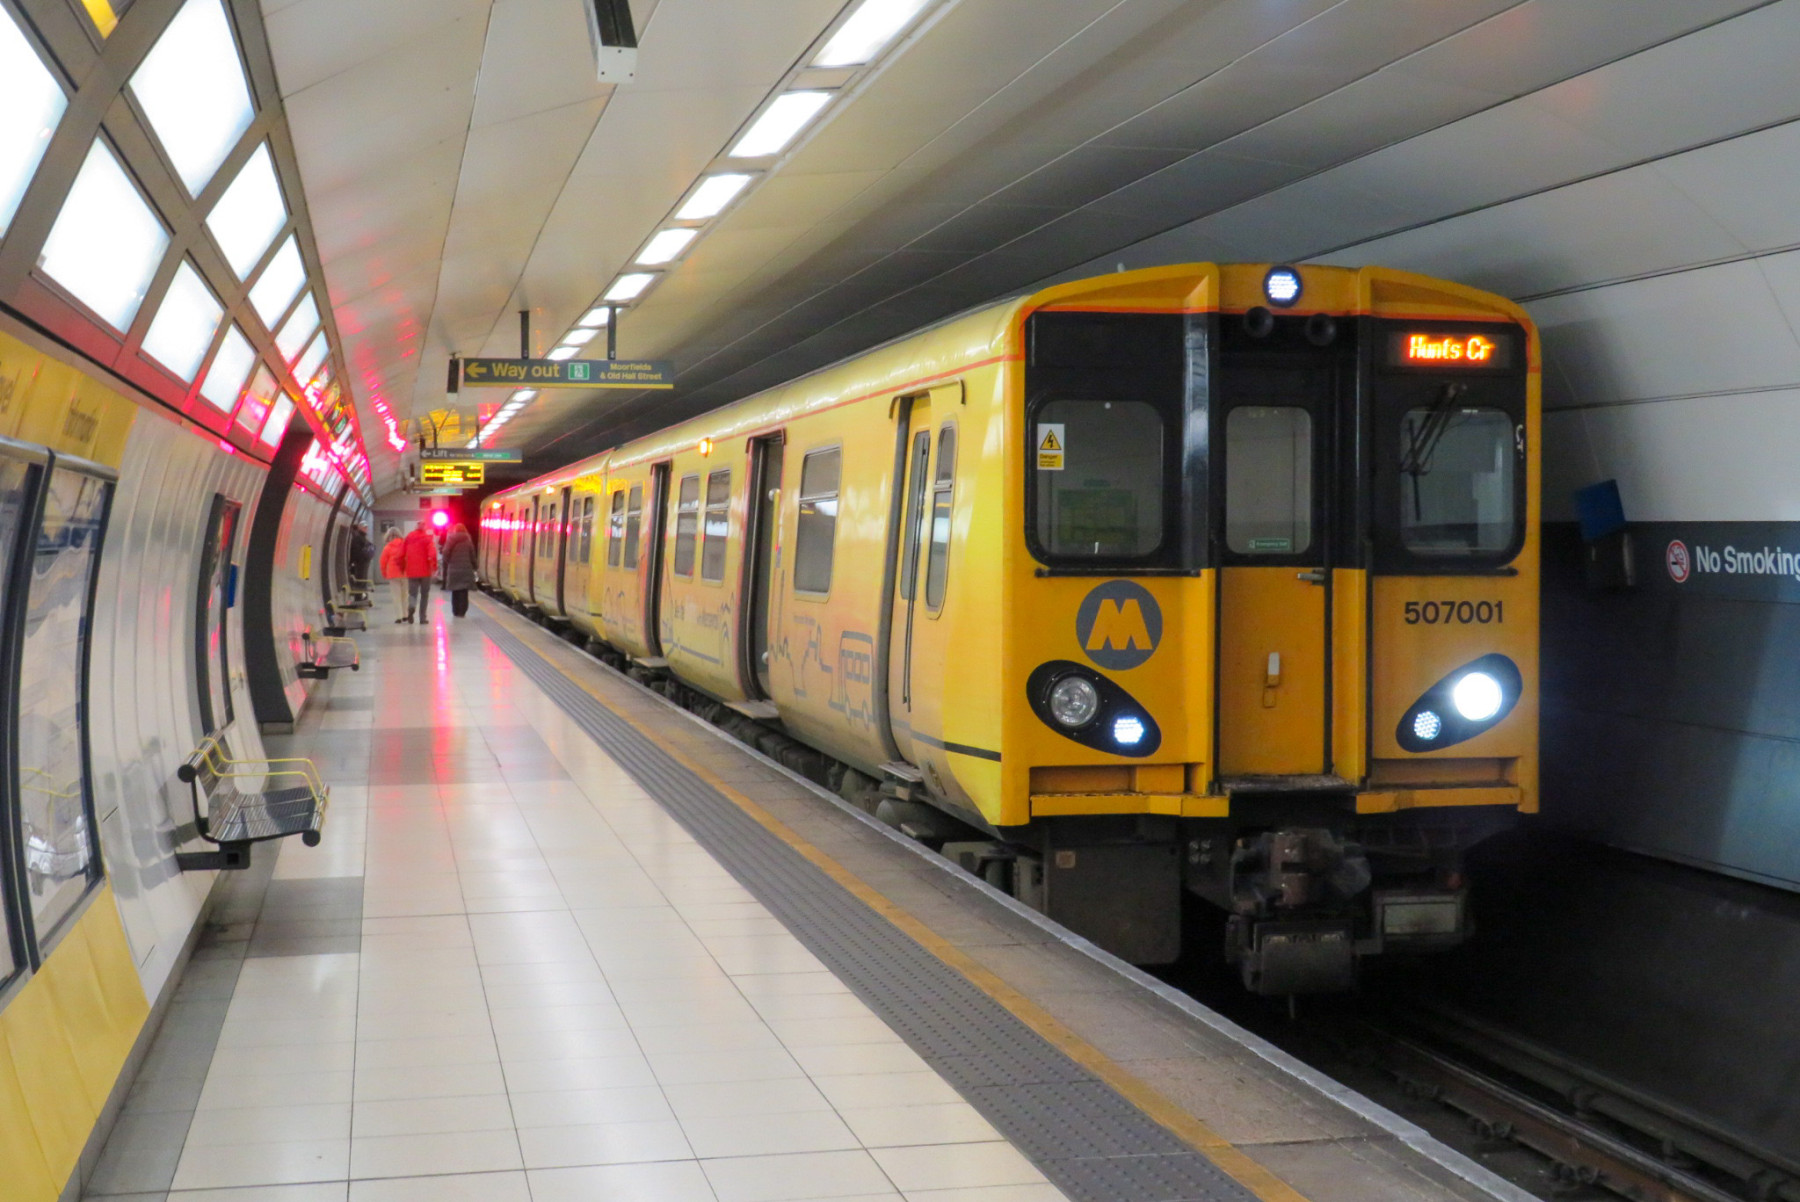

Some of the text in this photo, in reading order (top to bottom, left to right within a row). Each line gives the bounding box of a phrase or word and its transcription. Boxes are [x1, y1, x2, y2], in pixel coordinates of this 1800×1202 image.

[1408, 334, 1495, 361] Hunts Cr
[492, 363, 560, 380] Way out
[610, 363, 652, 371] Moorfields
[607, 372, 621, 380] Old
[622, 372, 637, 380] Hall
[432, 450, 448, 458] Lift
[1695, 546, 1721, 573] No
[1404, 600, 1503, 624] 507001
